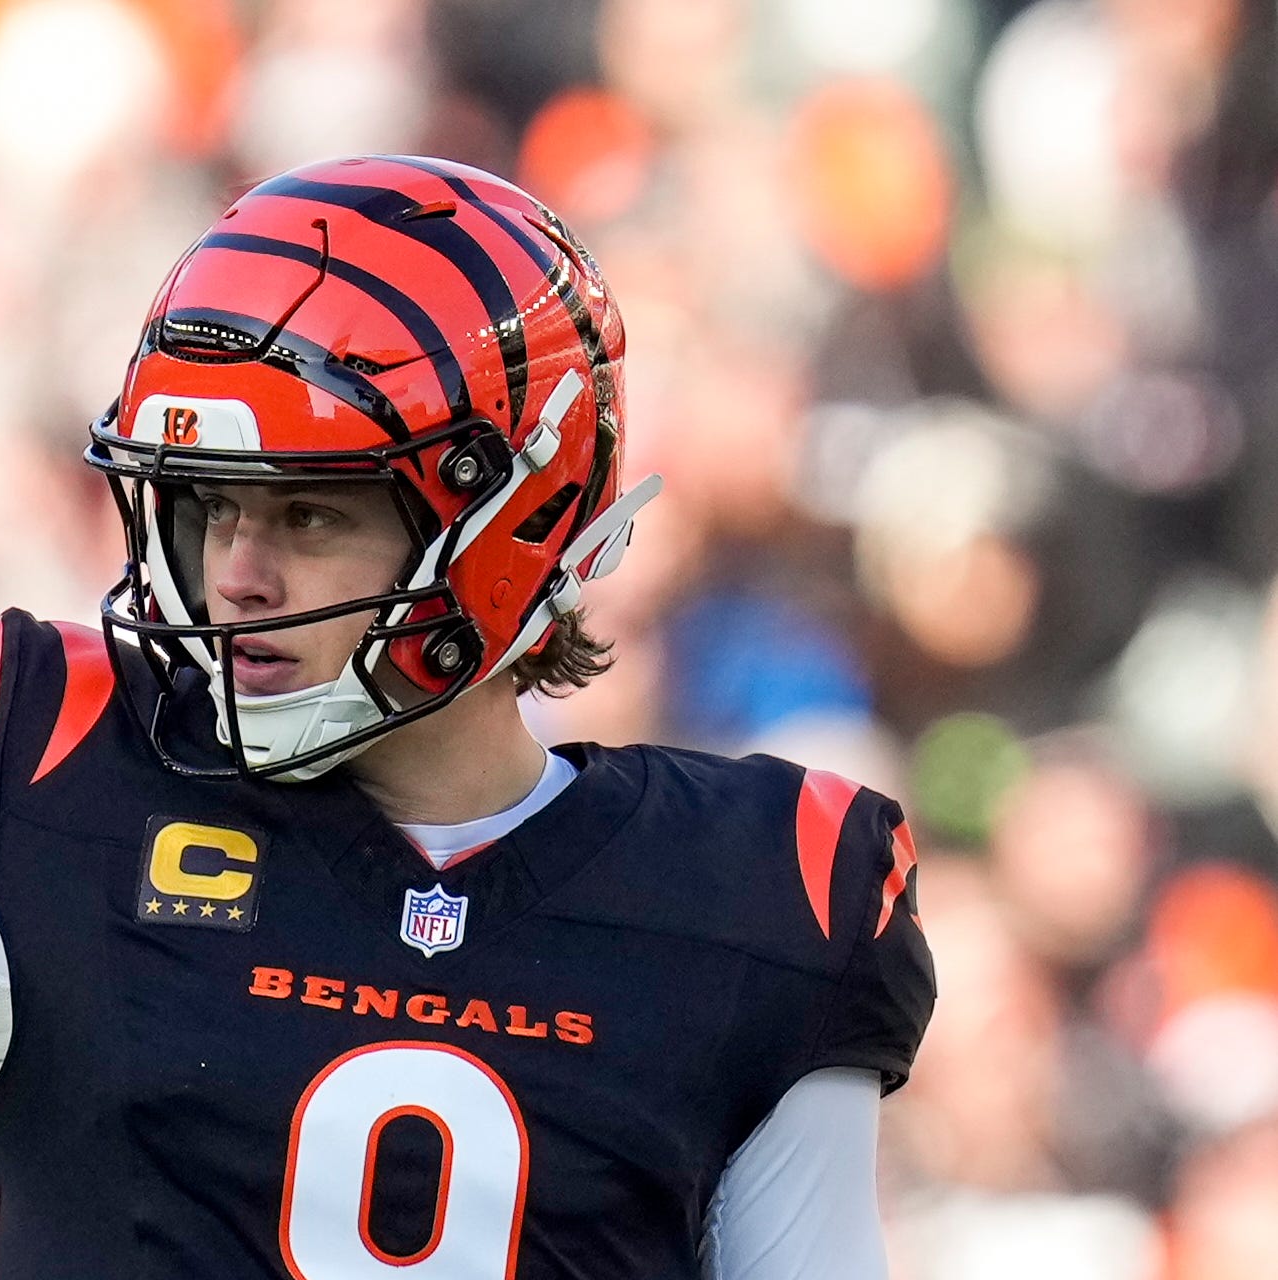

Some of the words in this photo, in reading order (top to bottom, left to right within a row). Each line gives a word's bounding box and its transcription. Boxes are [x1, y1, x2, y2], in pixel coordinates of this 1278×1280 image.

[148, 821, 259, 901] C
[411, 914, 452, 943] NFL
[248, 966, 595, 1046] BENGALS
